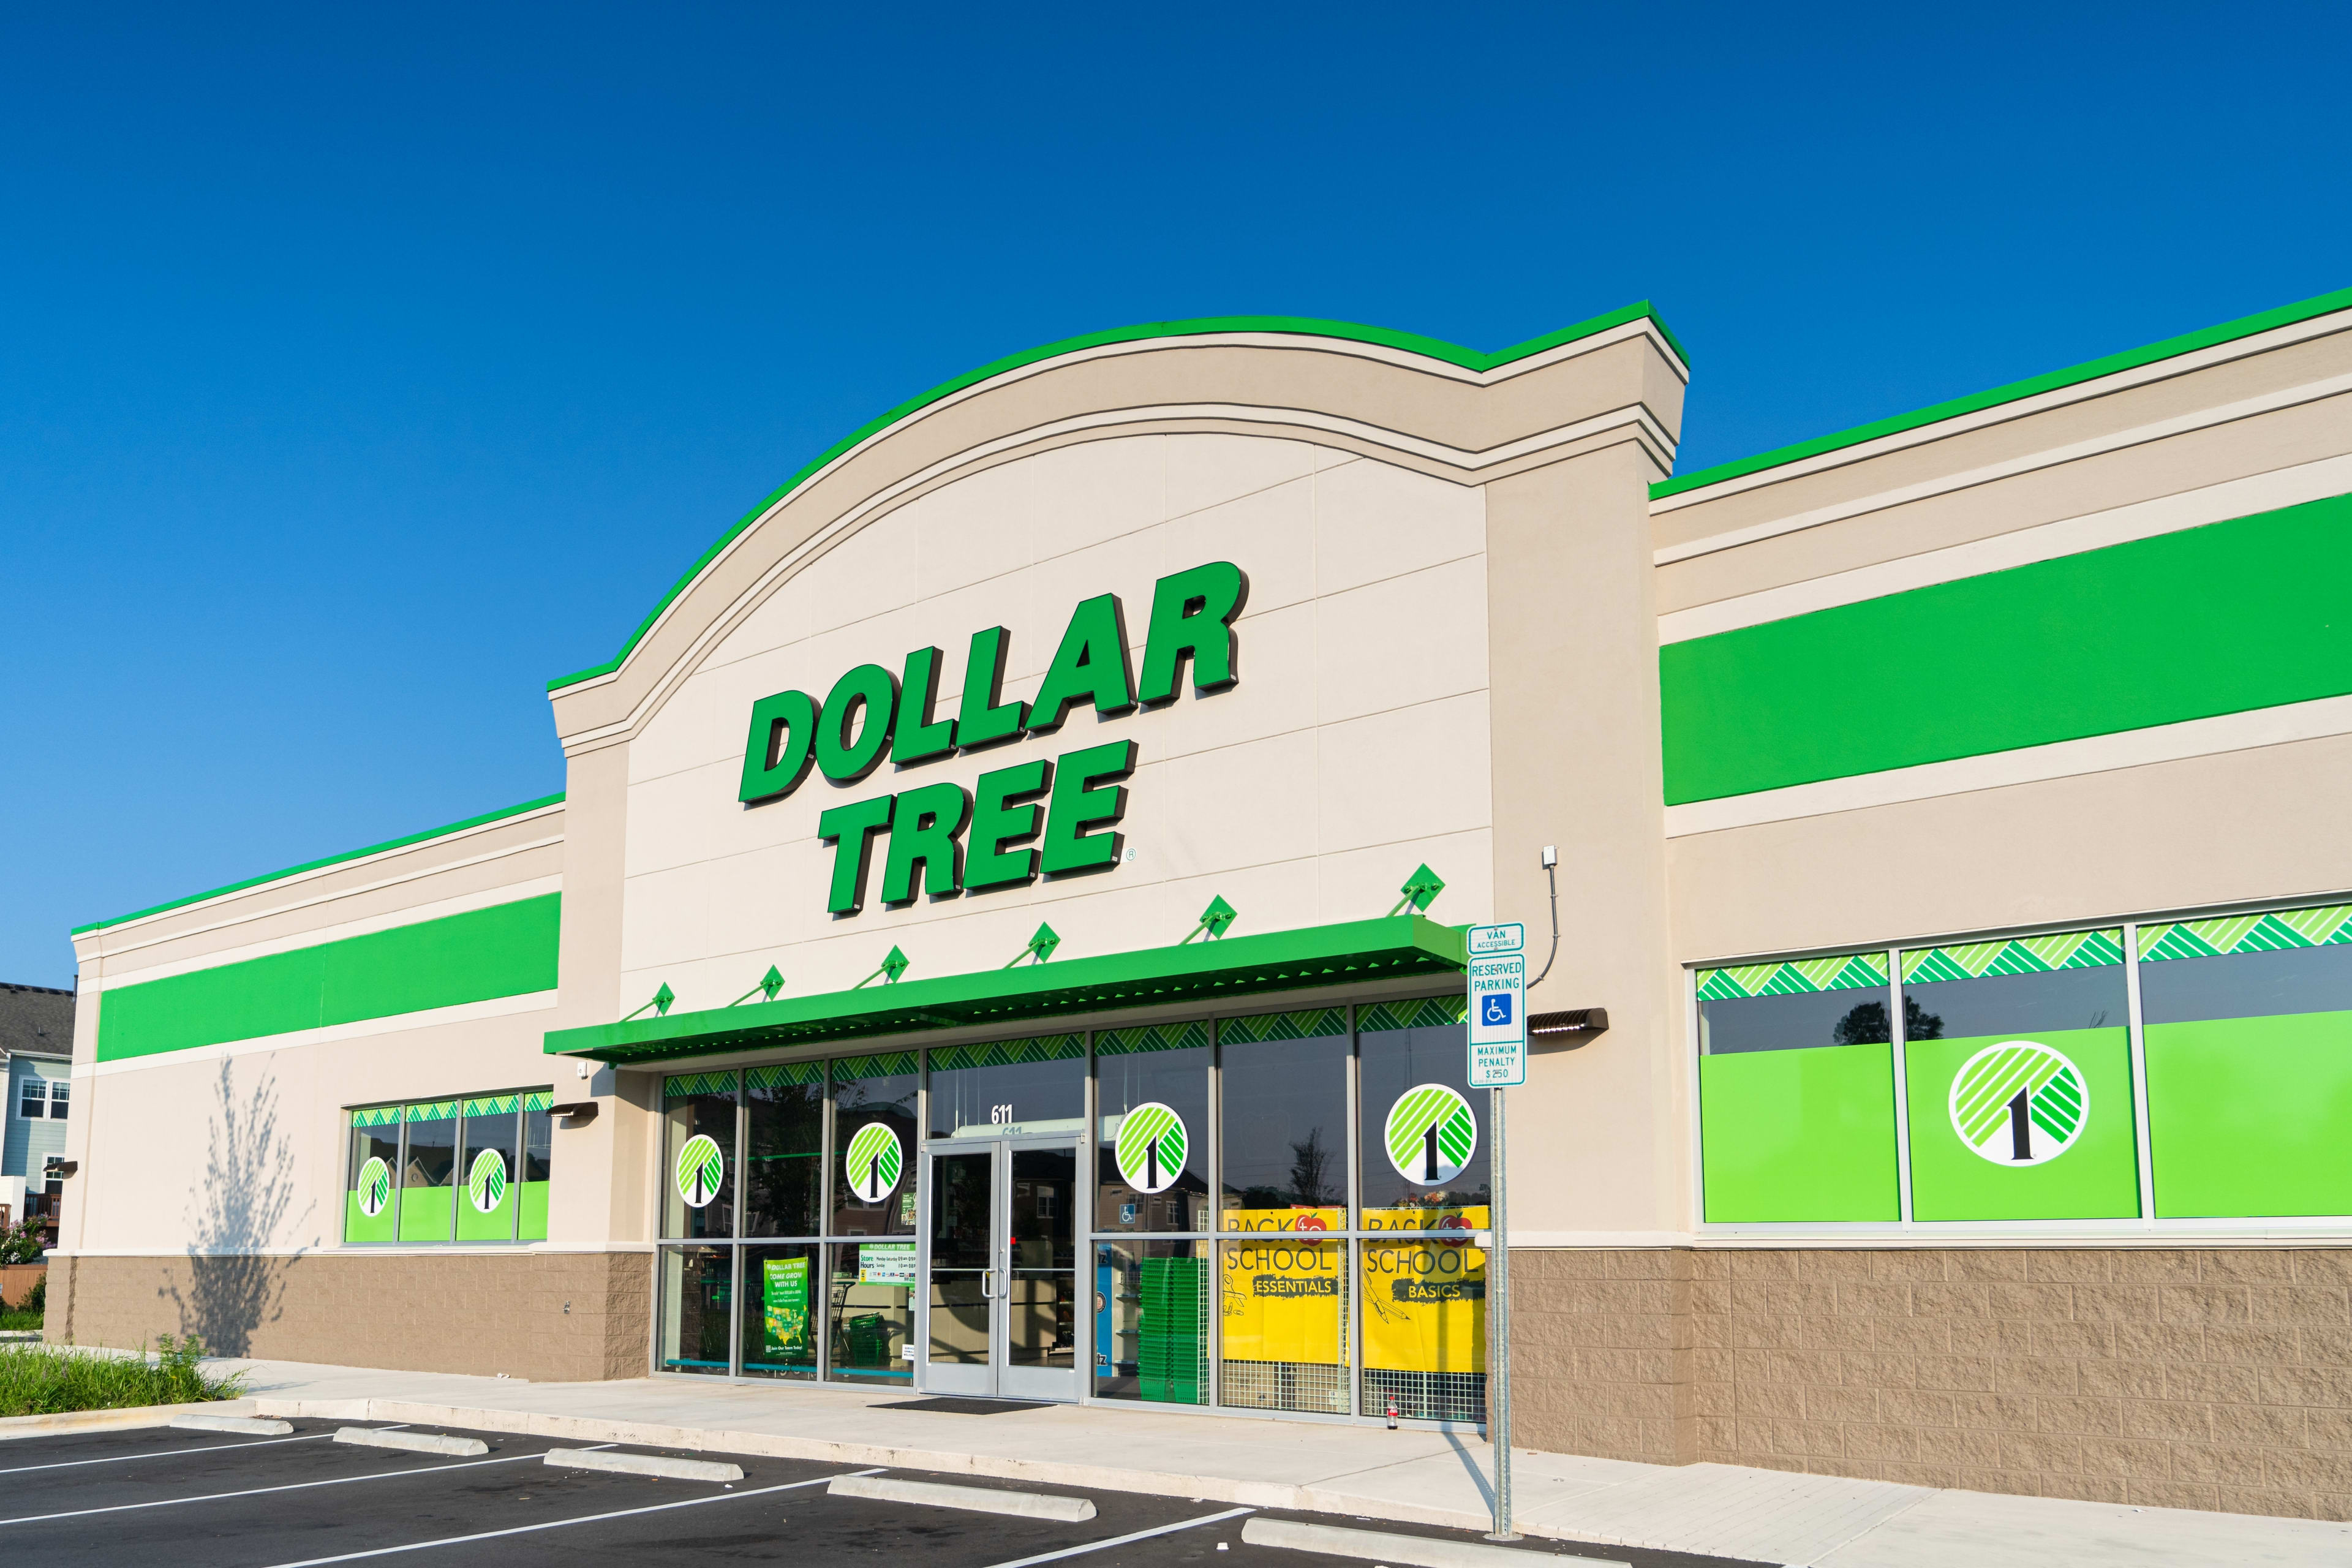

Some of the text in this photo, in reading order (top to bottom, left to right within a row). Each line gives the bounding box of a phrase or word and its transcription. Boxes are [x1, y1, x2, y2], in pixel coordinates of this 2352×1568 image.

[739, 560, 1250, 805] DOLLAR
[818, 739, 1139, 914] TREE
[1487, 930, 1506, 940] VAN
[1477, 939, 1516, 949] ACCESSIBLE
[1472, 962, 1521, 977] RESERVED
[1474, 977, 1520, 992] PARKING
[1477, 1045, 1517, 1056] MAXIMUM
[1479, 1057, 1515, 1067] PENALTY
[991, 1104, 1012, 1125] 611
[1227, 1218, 1297, 1243] BACK
[1368, 1218, 1439, 1245] BACK
[1227, 1247, 1332, 1271] SCHOOL
[1366, 1248, 1479, 1275] SCHOOL
[1256, 1280, 1332, 1293] ESSENTIALS
[1408, 1284, 1461, 1298] BASICS
[1098, 1352, 1108, 1366] tz
